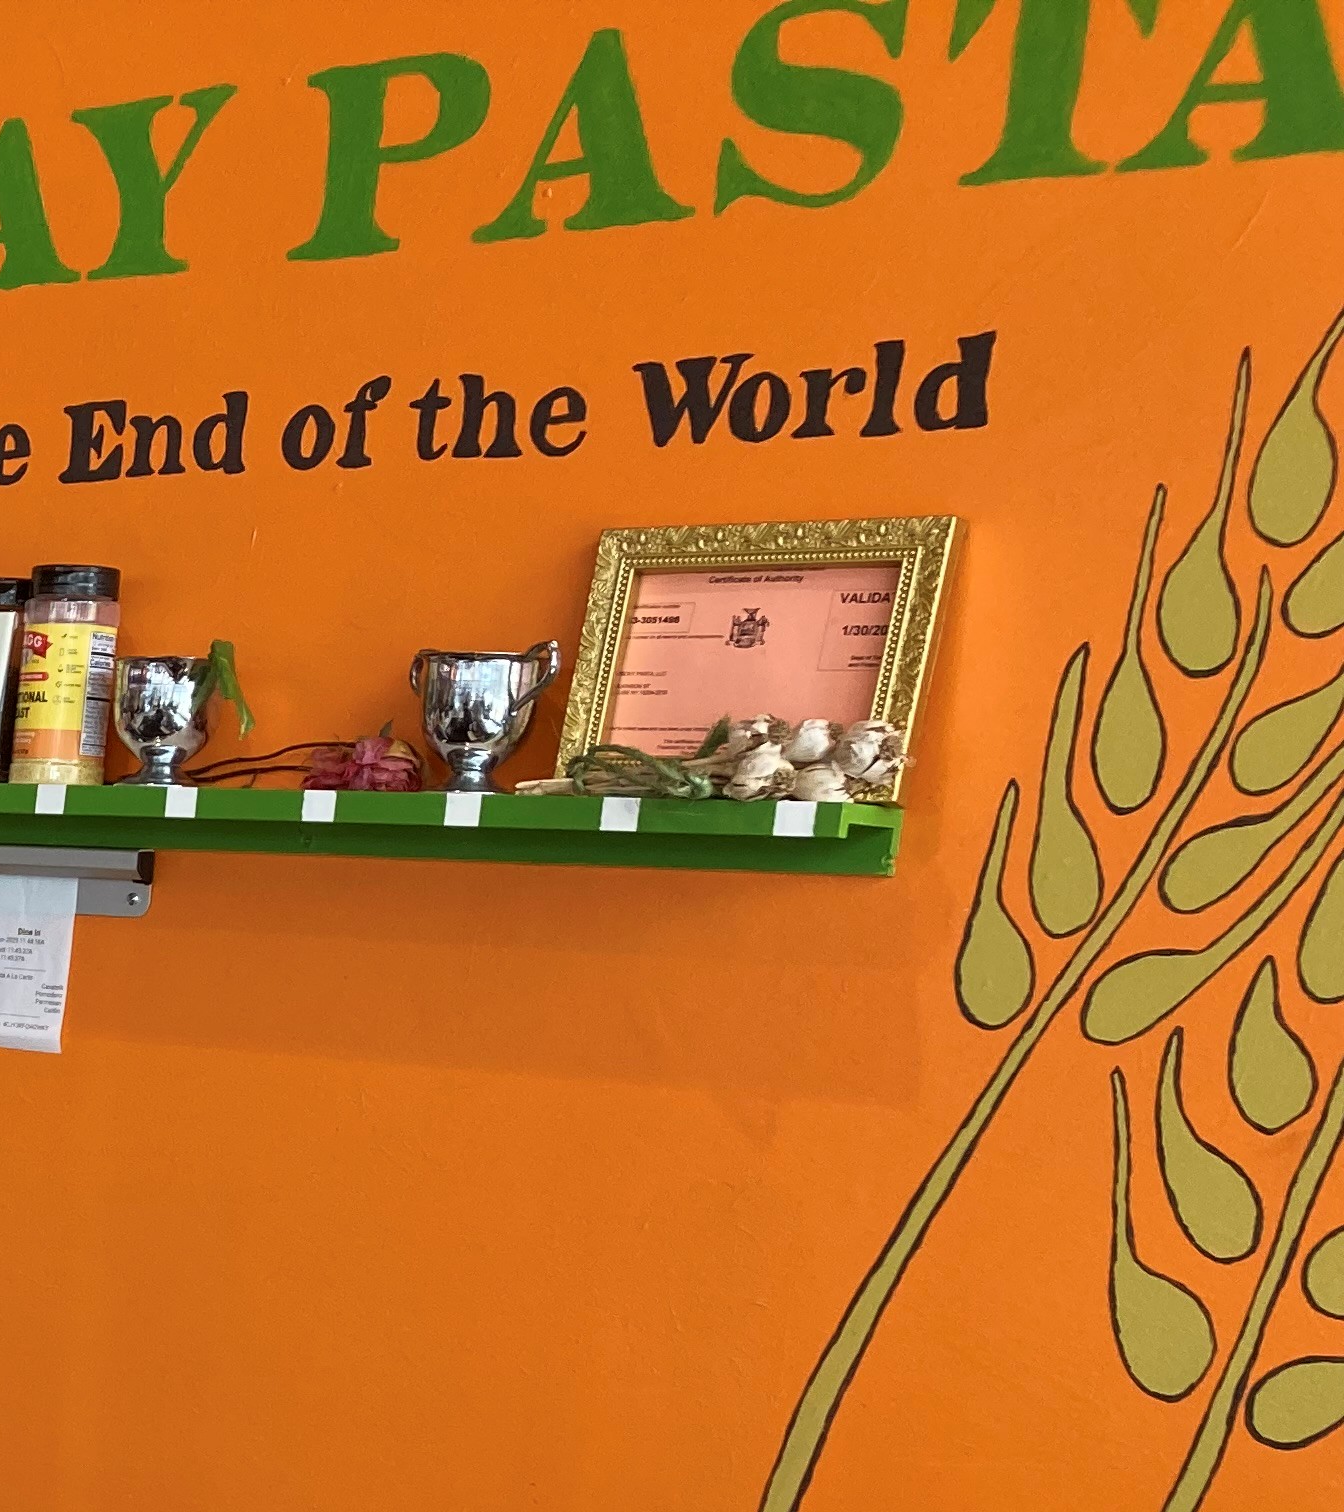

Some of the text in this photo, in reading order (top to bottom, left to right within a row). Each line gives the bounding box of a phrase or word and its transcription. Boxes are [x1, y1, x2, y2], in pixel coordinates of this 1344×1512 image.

[286, 0, 1344, 262] PASTA
[57, 391, 250, 483] End
[281, 373, 393, 472] of
[409, 371, 588, 459] the
[632, 330, 997, 449] World
[708, 573, 805, 585] Certificate of Authority
